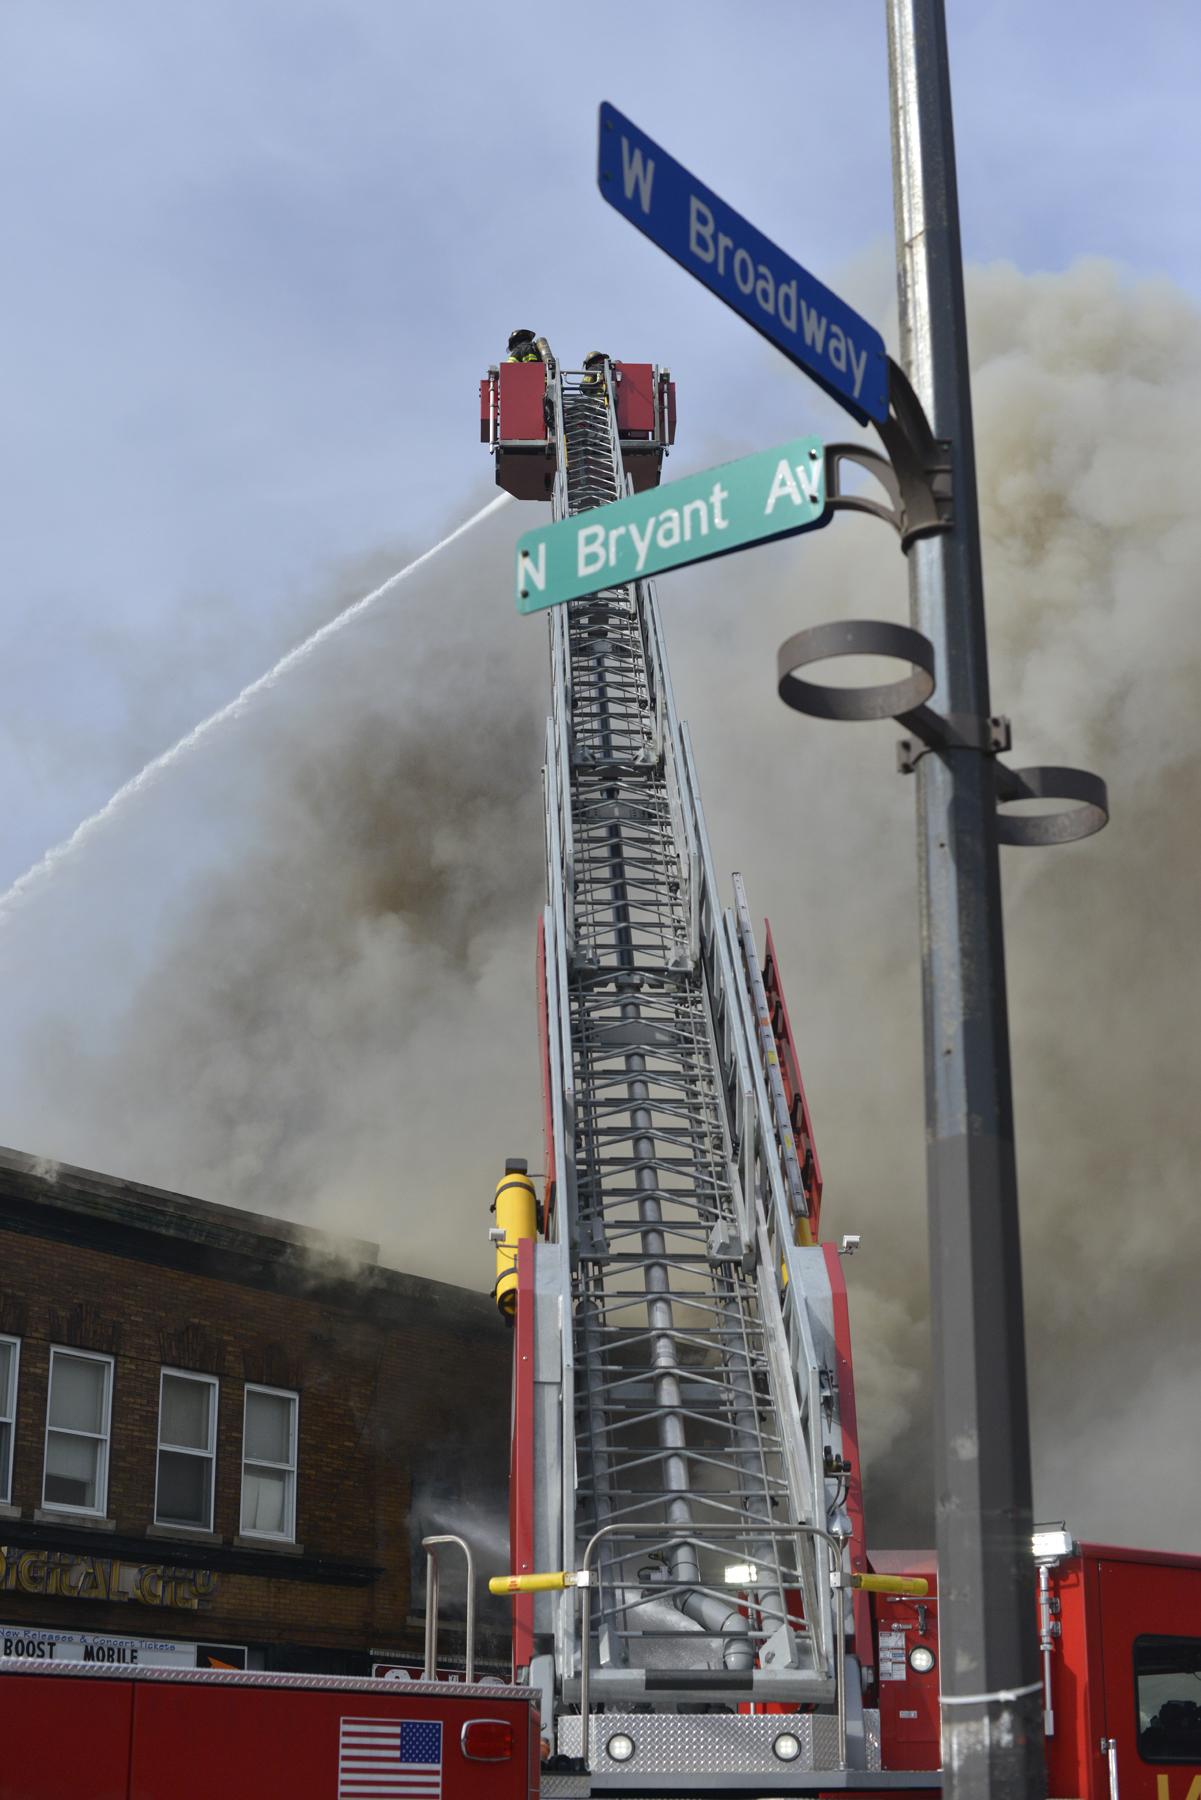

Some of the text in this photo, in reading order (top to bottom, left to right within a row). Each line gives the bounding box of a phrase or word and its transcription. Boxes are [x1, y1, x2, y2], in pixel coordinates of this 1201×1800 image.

[621, 135, 868, 399] W Broadway
[517, 458, 821, 590] N Bryant Av
[0, 1547, 129, 1602] IGITAL
[3, 1638, 138, 1664] BOOST MOBILE
[23, 1630, 74, 1642] Releases
[80, 1635, 88, 1643] &
[93, 1636, 135, 1648] Concert
[140, 1640, 176, 1651] Tickets
